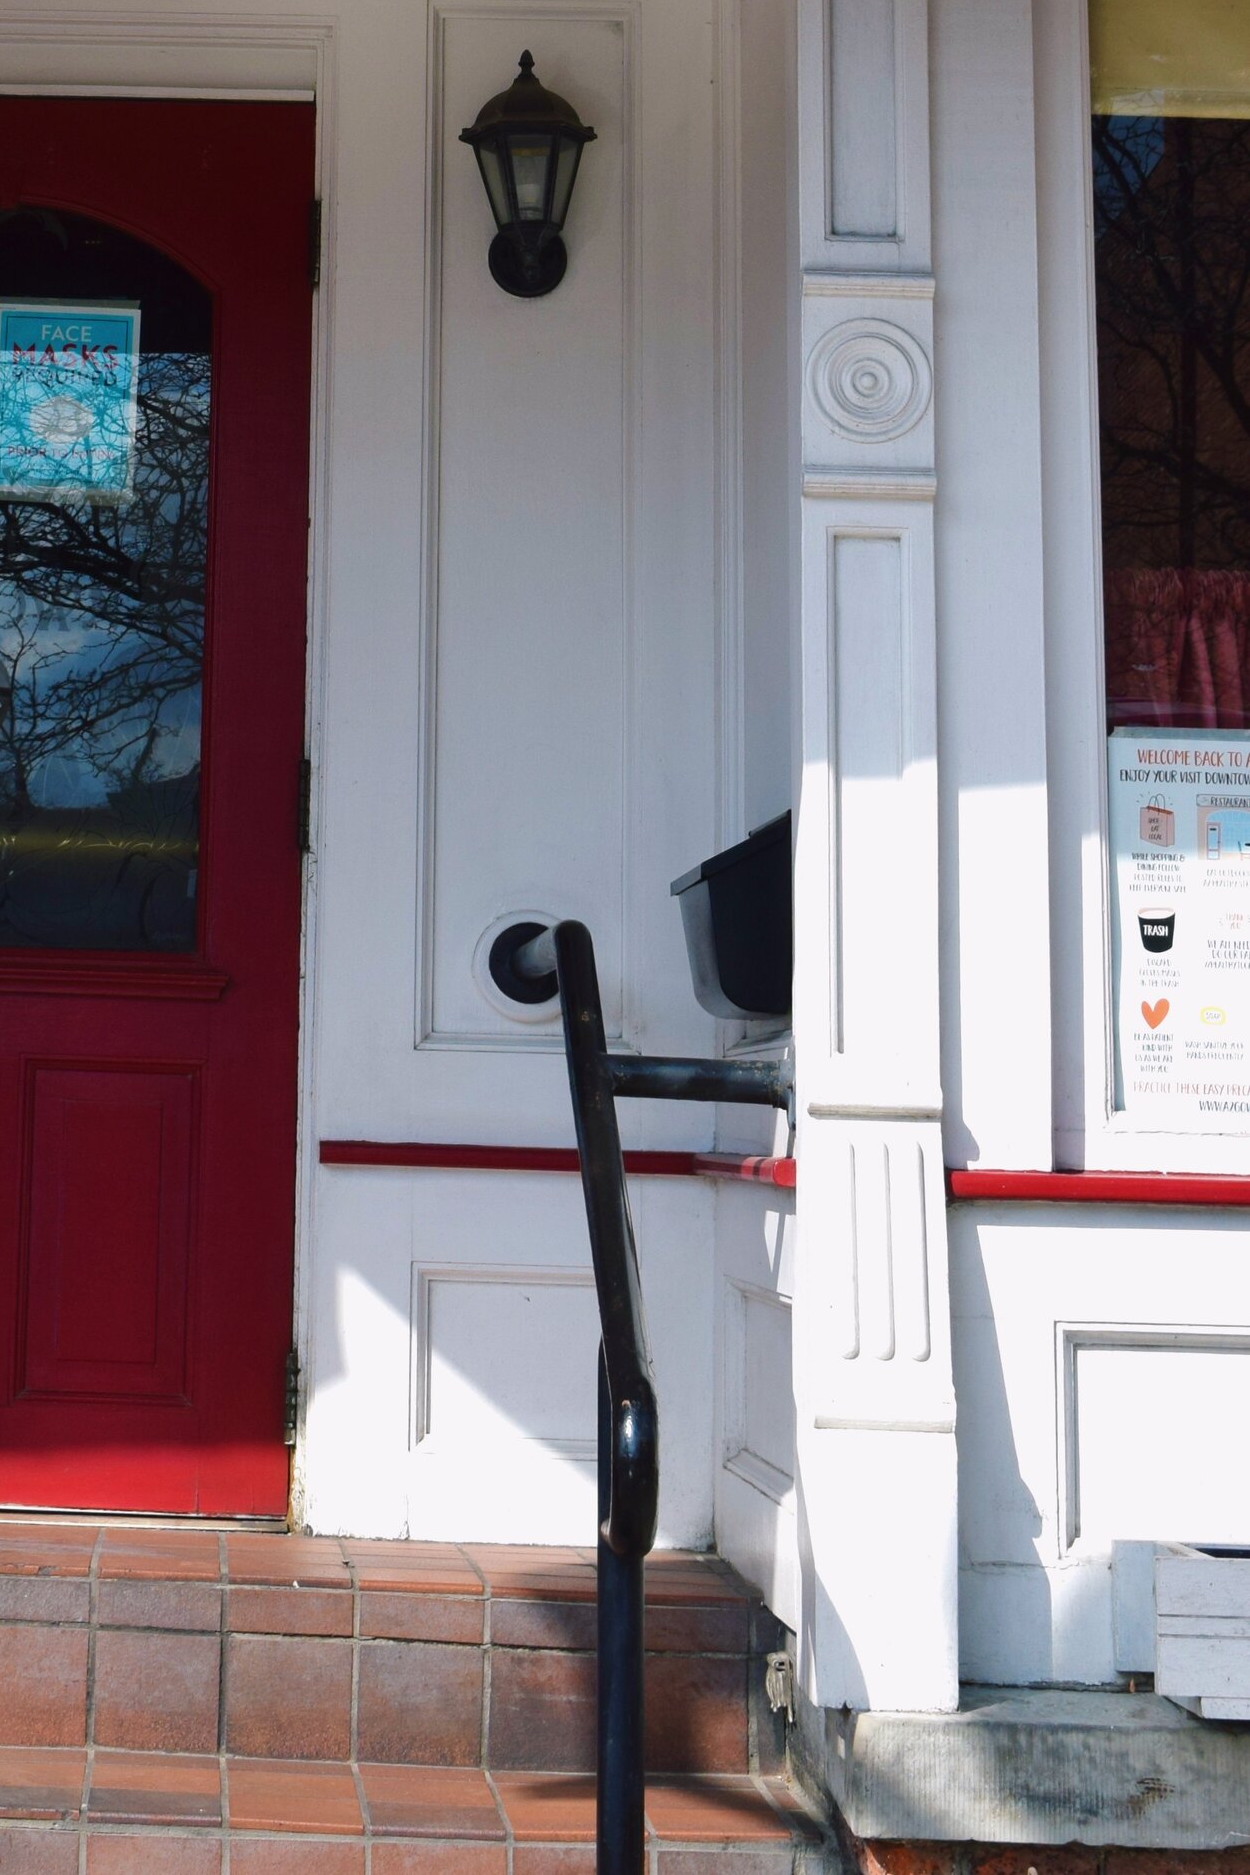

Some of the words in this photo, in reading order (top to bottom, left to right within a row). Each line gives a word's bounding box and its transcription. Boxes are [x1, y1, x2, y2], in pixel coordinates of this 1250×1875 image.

[41, 324, 92, 342] FACE
[13, 342, 118, 369] MASKS
[1137, 749, 1190, 765] WELCOME
[1194, 751, 1224, 767] BACK
[1227, 751, 1242, 767] TO
[1119, 769, 1150, 782] ENJOY
[1152, 770, 1177, 783] YOUR
[1180, 771, 1202, 784] VISIT
[1143, 925, 1168, 936] TRASH
[1203, 1084, 1225, 1095] EASY
